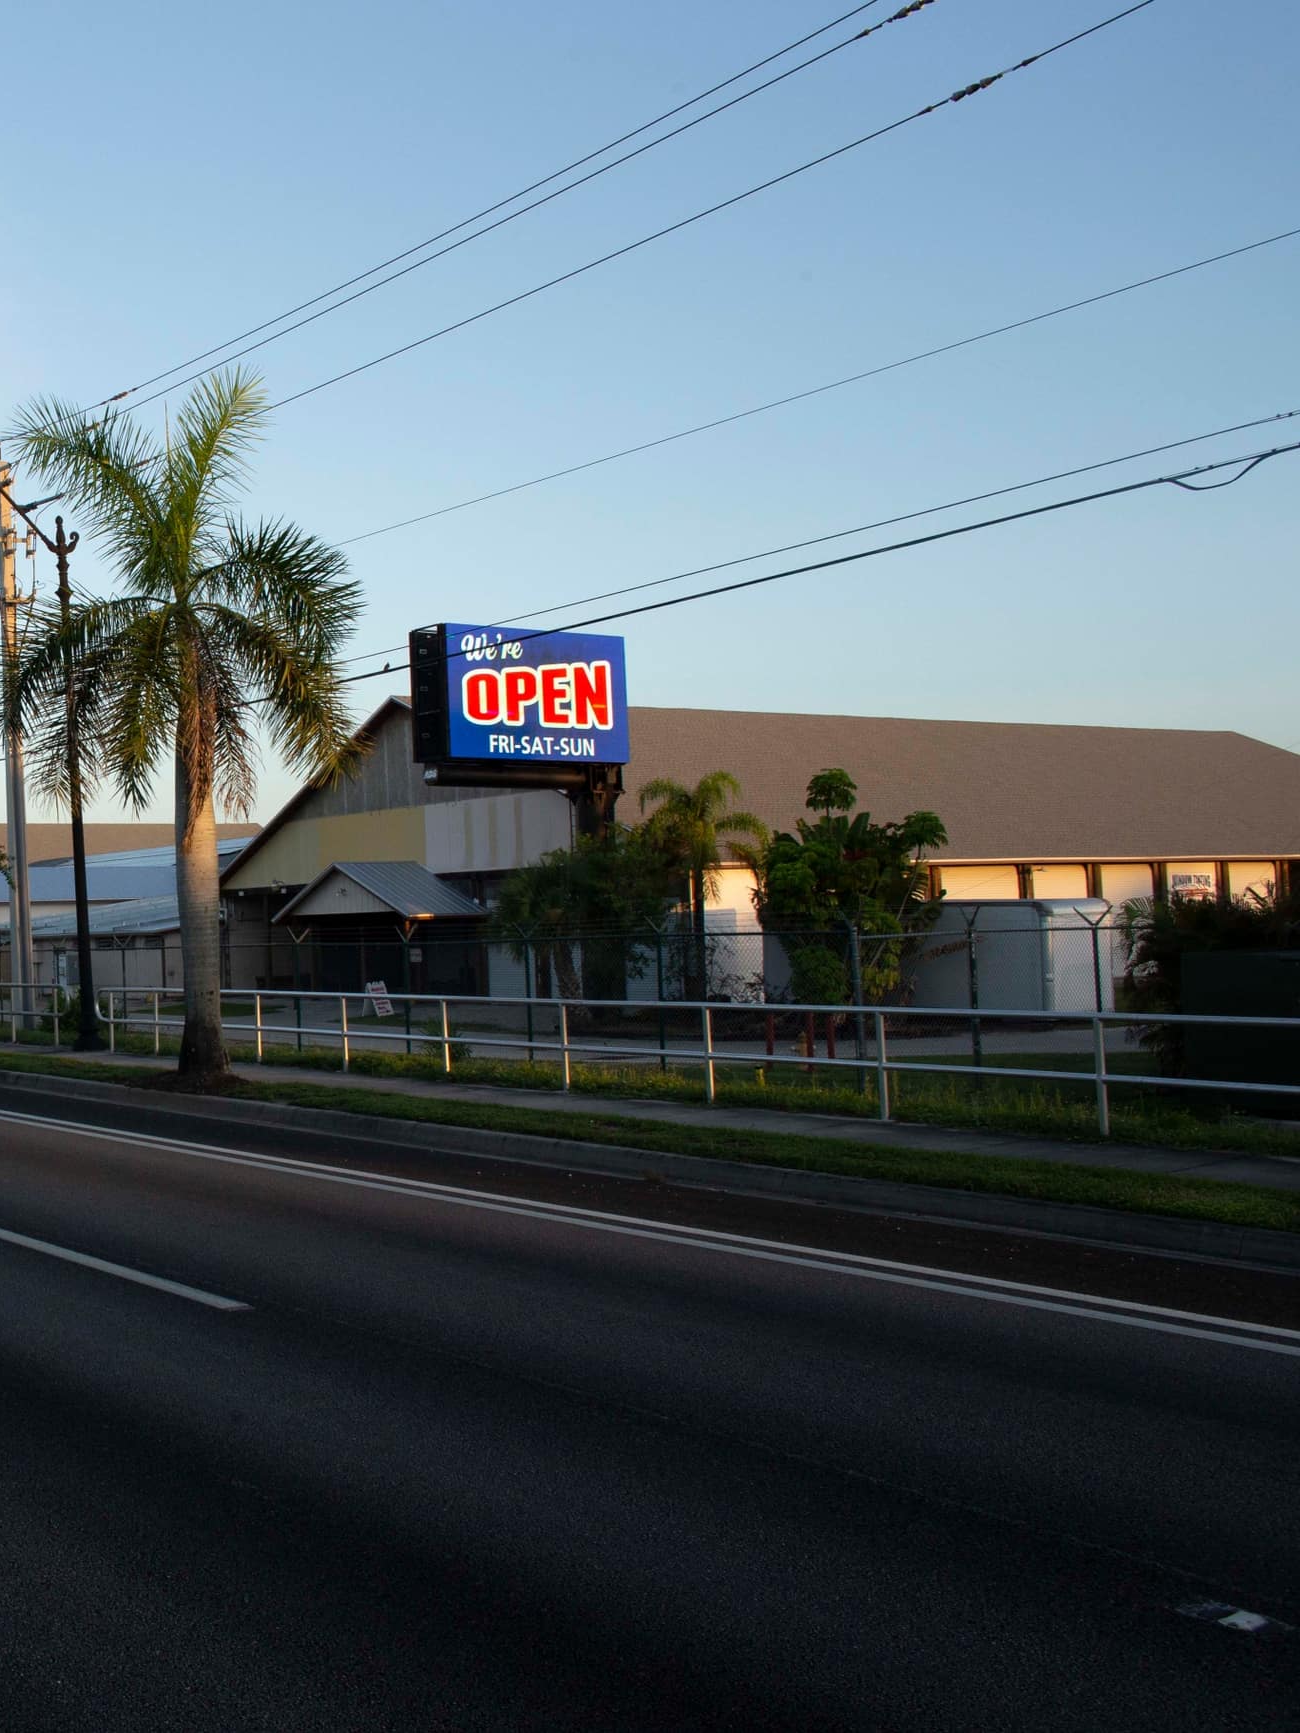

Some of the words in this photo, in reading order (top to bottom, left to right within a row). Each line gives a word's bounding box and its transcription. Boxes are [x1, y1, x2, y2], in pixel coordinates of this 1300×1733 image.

[461, 633, 523, 661] We're
[462, 661, 613, 730] OPEN
[489, 735, 595, 756] FRI-SAT-SUN
